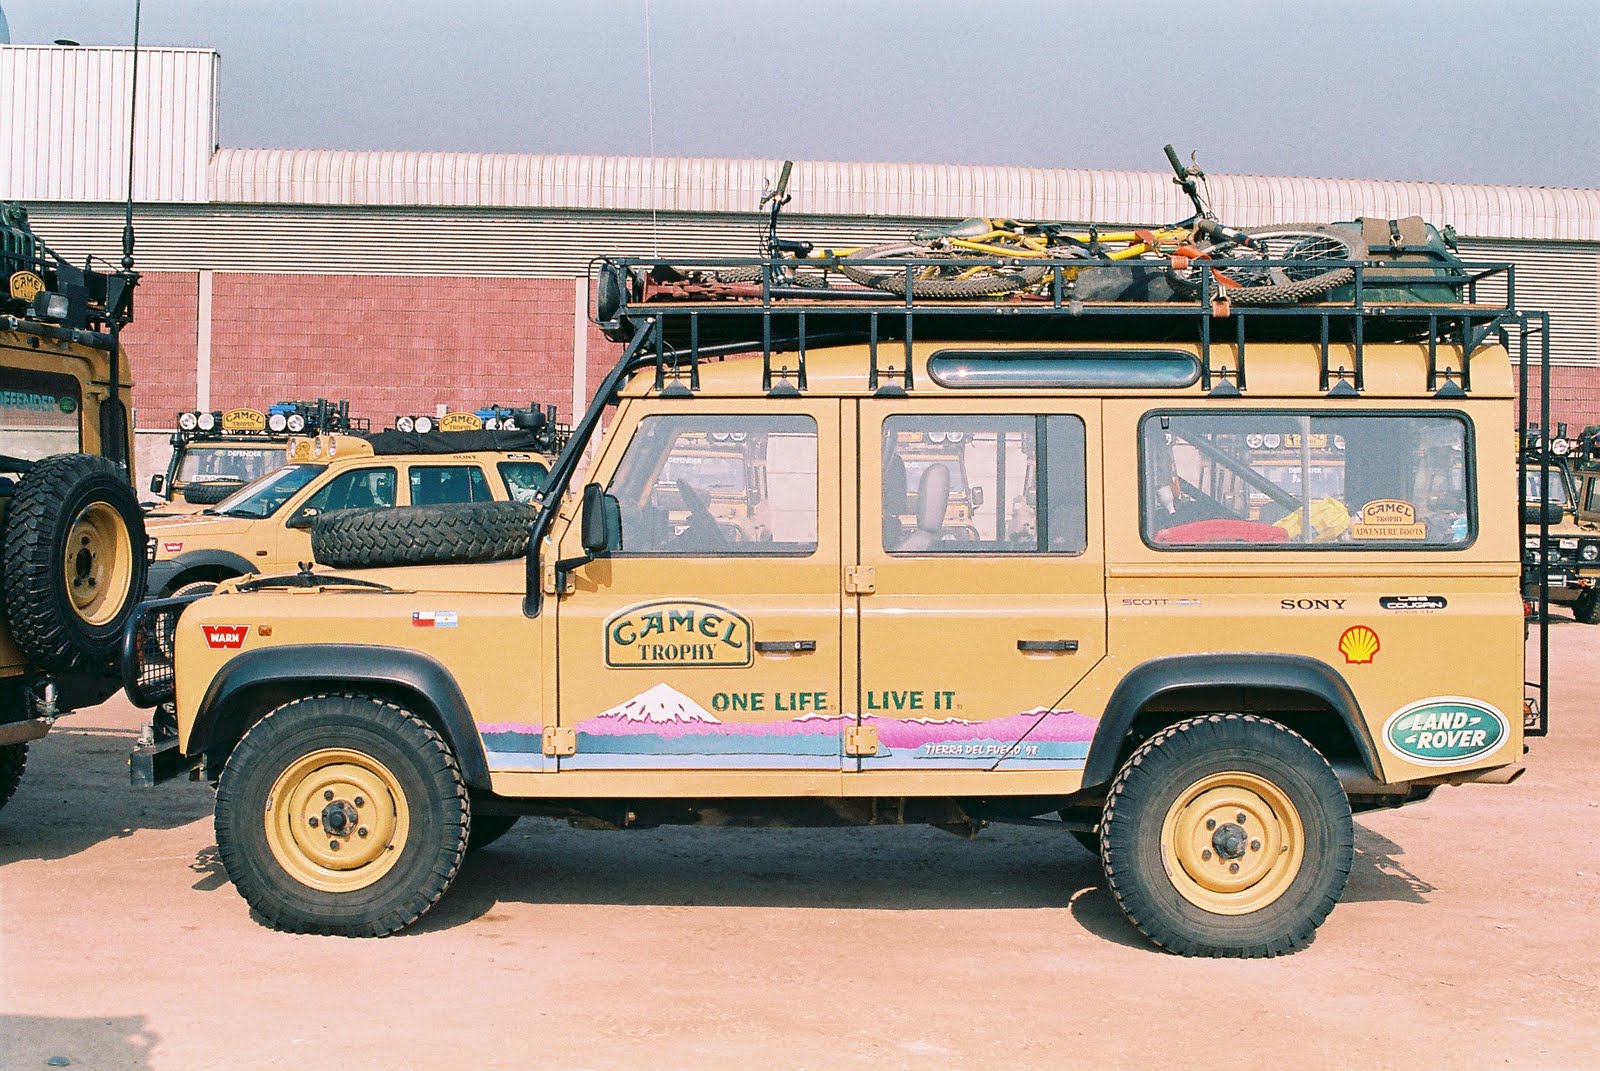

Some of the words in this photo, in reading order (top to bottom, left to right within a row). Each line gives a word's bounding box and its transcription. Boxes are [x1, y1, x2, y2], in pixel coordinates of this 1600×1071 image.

[225, 412, 262, 424] CAMEL
[442, 415, 479, 428] CAMEL
[1367, 503, 1412, 517] CAMEL
[1376, 515, 1403, 523] TROPHY
[1355, 527, 1397, 536] ADVENTURE
[1399, 527, 1424, 536] BOOTS
[1122, 598, 1168, 606] SCOTT
[1280, 599, 1347, 610] SONY
[613, 609, 743, 649] CAMEL
[210, 633, 240, 643] WARN
[637, 643, 718, 661] TROPHY
[711, 691, 765, 712] ONE
[774, 691, 828, 711] LIFE
[867, 690, 924, 710] LIVE
[934, 690, 956, 710] IT
[925, 744, 964, 756] TIERRA
[965, 744, 985, 755] DEL
